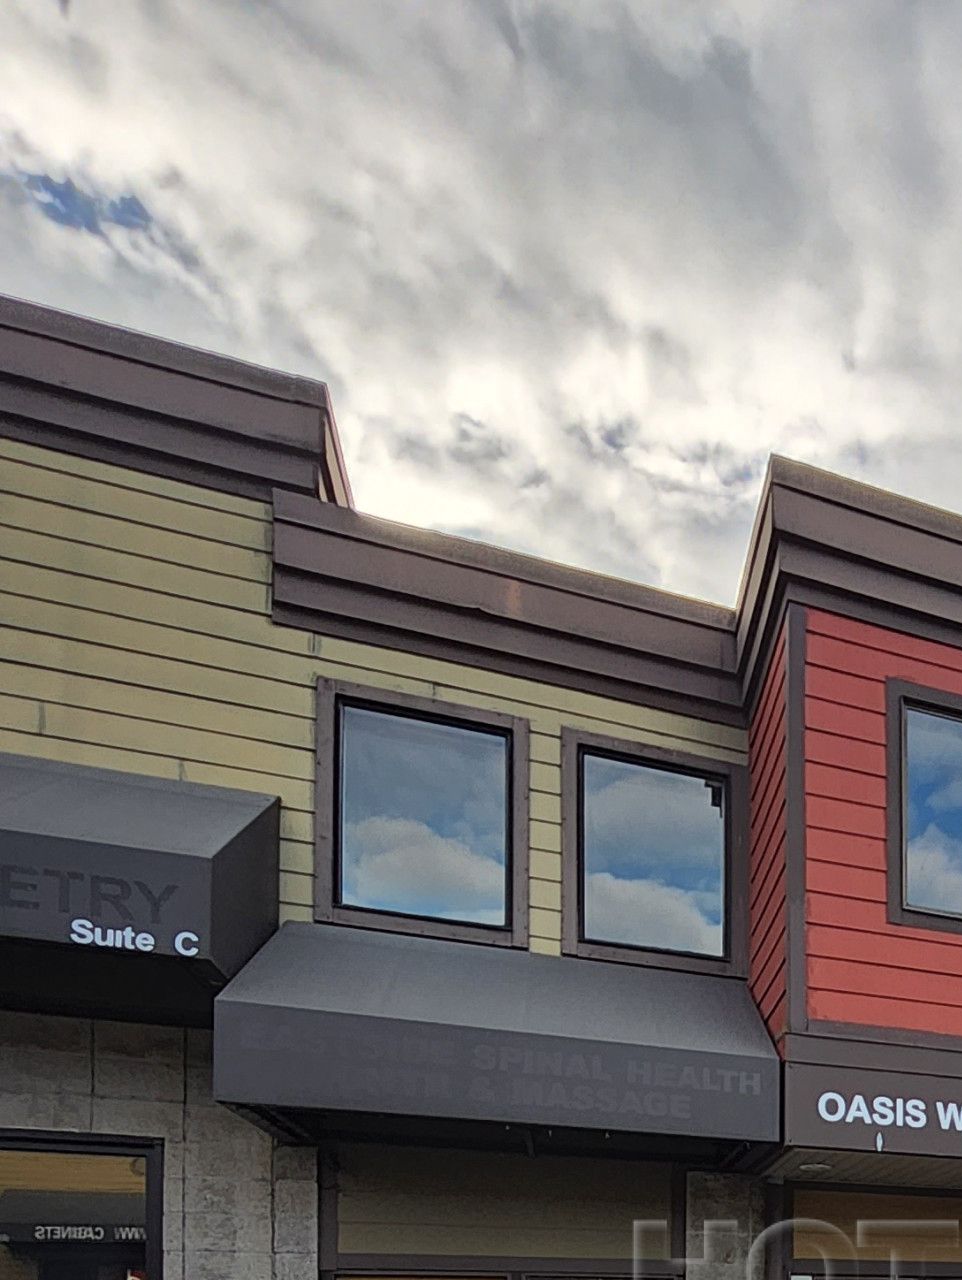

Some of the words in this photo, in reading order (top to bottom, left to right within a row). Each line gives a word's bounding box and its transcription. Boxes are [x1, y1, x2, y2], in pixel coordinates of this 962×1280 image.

[69, 918, 155, 951] Suite
[174, 931, 199, 957] C
[470, 1044, 611, 1083] SPINAL
[627, 1059, 762, 1096] HEALTH
[511, 1075, 692, 1119] MASSAGE
[817, 1091, 927, 1128] OASIS
